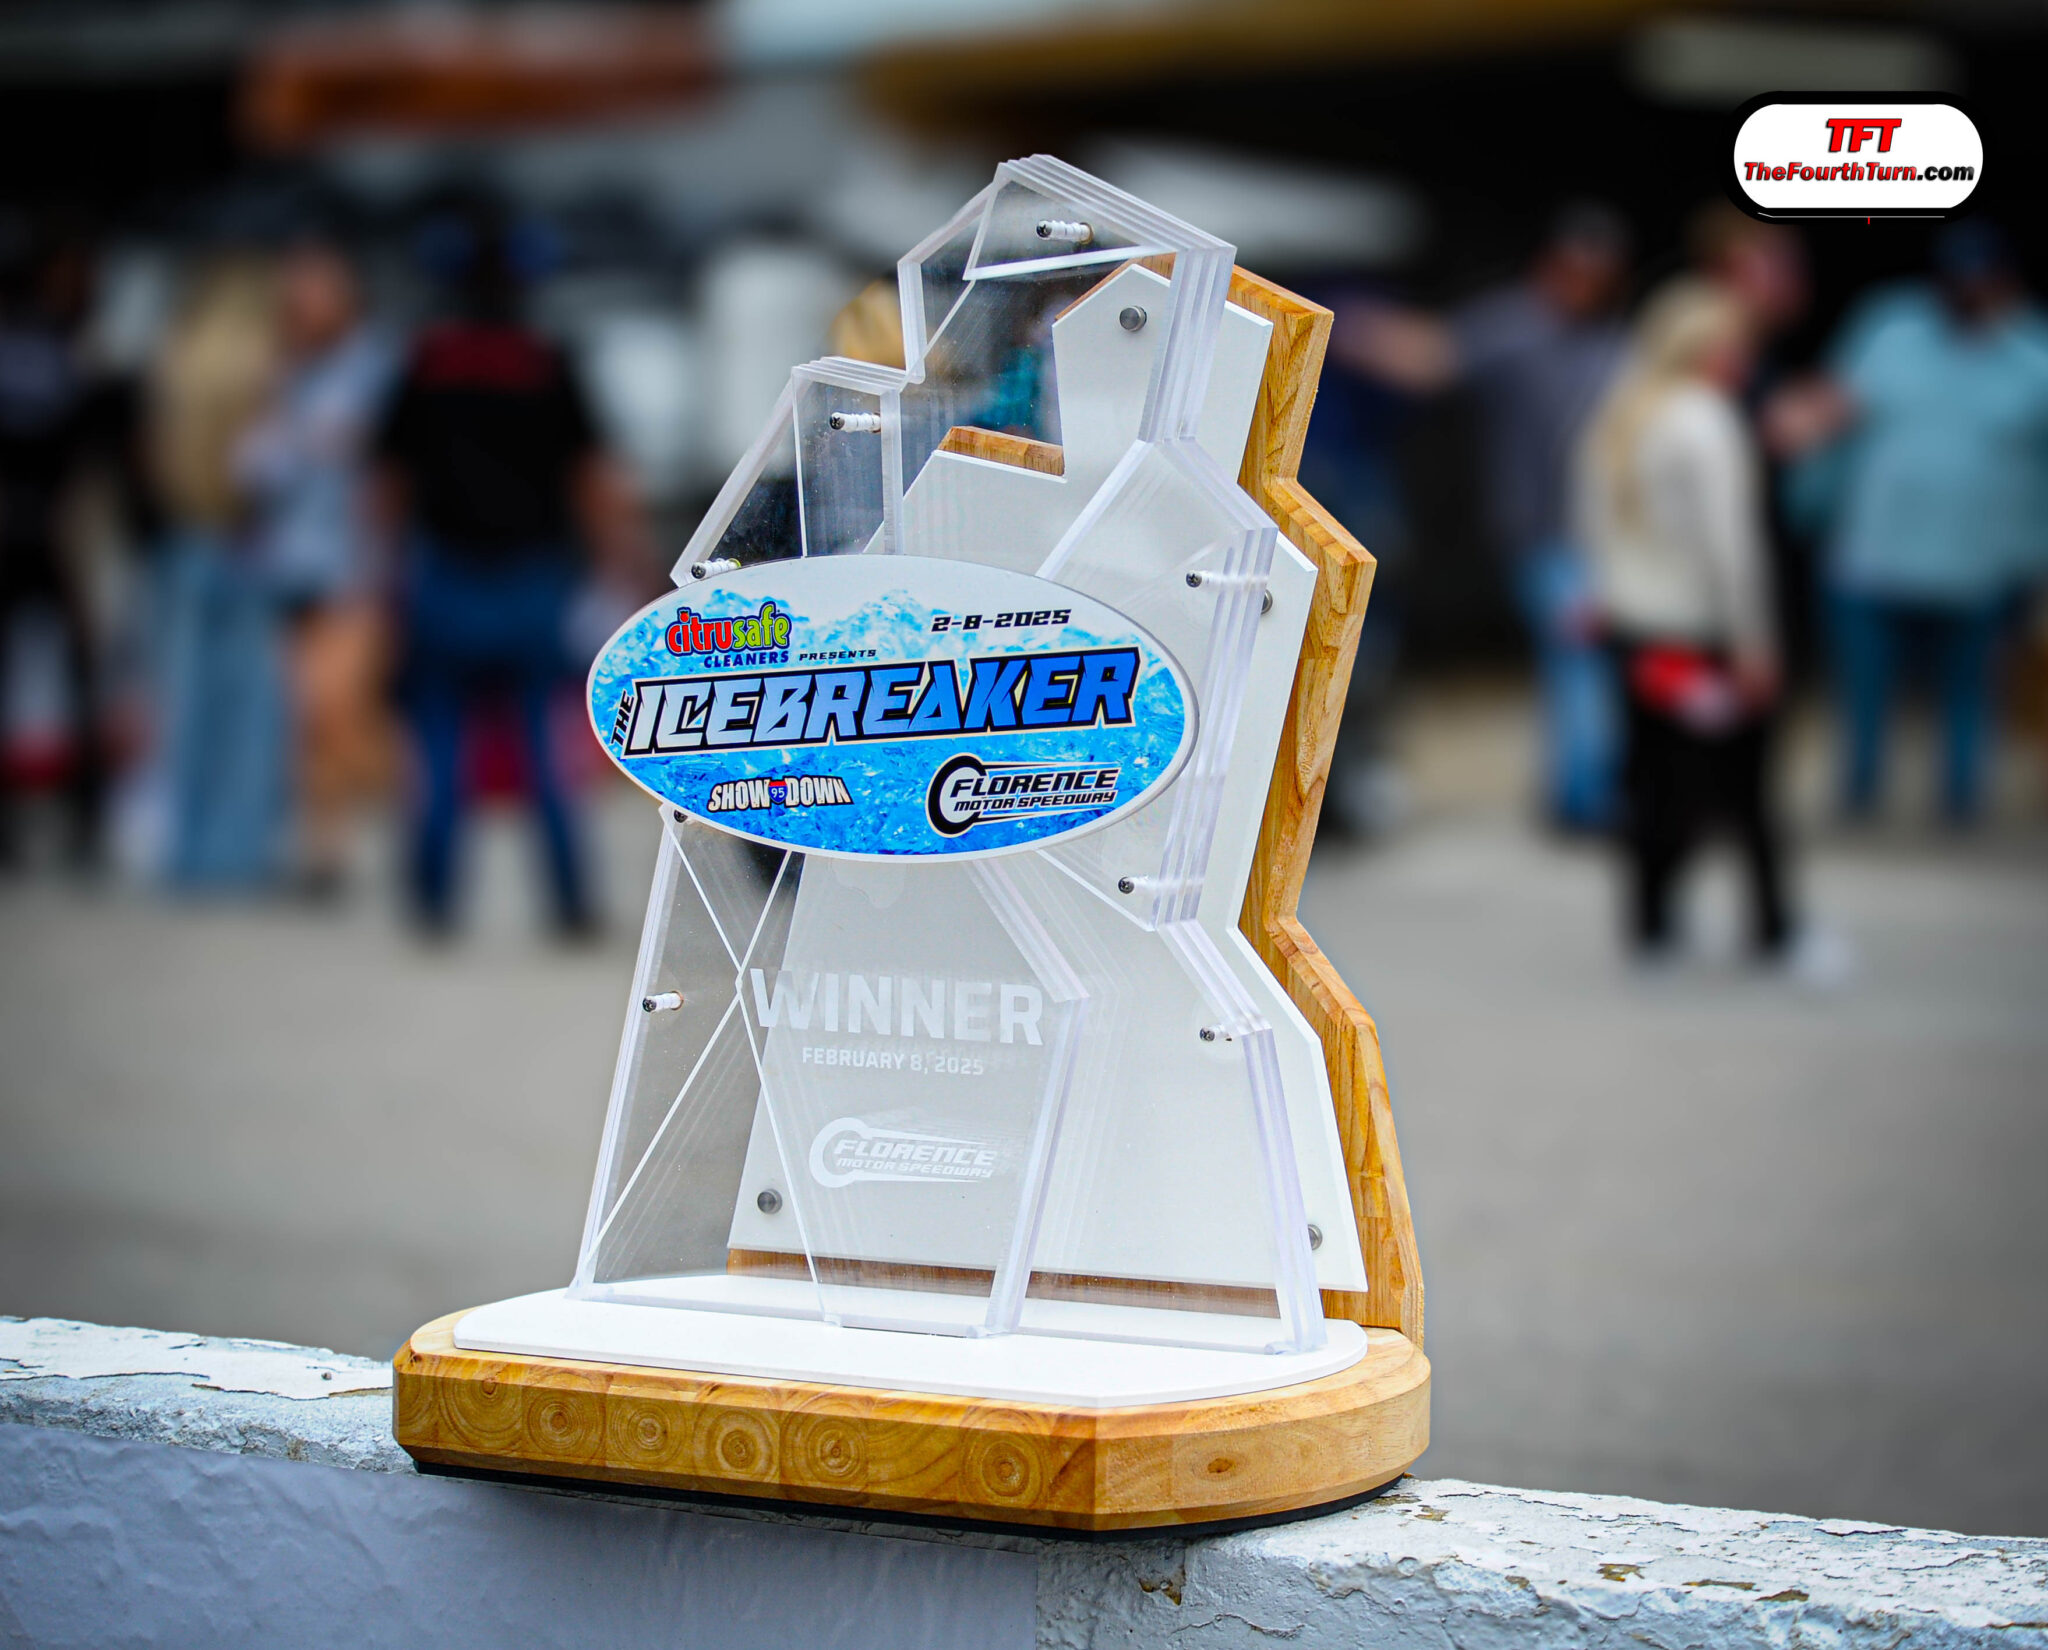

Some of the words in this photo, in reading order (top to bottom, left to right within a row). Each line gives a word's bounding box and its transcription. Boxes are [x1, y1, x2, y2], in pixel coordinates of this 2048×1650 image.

[666, 601, 791, 656] citrusafe
[931, 609, 1072, 632] 2-8-2025
[704, 650, 789, 668] CLEANERS
[799, 649, 877, 661] PRESENTS
[625, 648, 1140, 755] ICEBREAKER
[610, 689, 634, 747] THE
[708, 777, 772, 812] SHOW
[771, 787, 785, 799] 95
[783, 775, 854, 808] DOWN
[950, 769, 1120, 798] FLORENCE
[954, 798, 1015, 812] MOTOR
[1017, 791, 1116, 808] SPEEDWAY
[750, 968, 1043, 1046] WINNER
[802, 1047, 904, 1070] FEBRUARY
[910, 1055, 929, 1076] 8,
[935, 1056, 984, 1076] 2025
[833, 1139, 997, 1167] FLORENCE
[836, 1158, 896, 1171] MOTOR
[898, 1161, 994, 1179] SPEEDWAY
